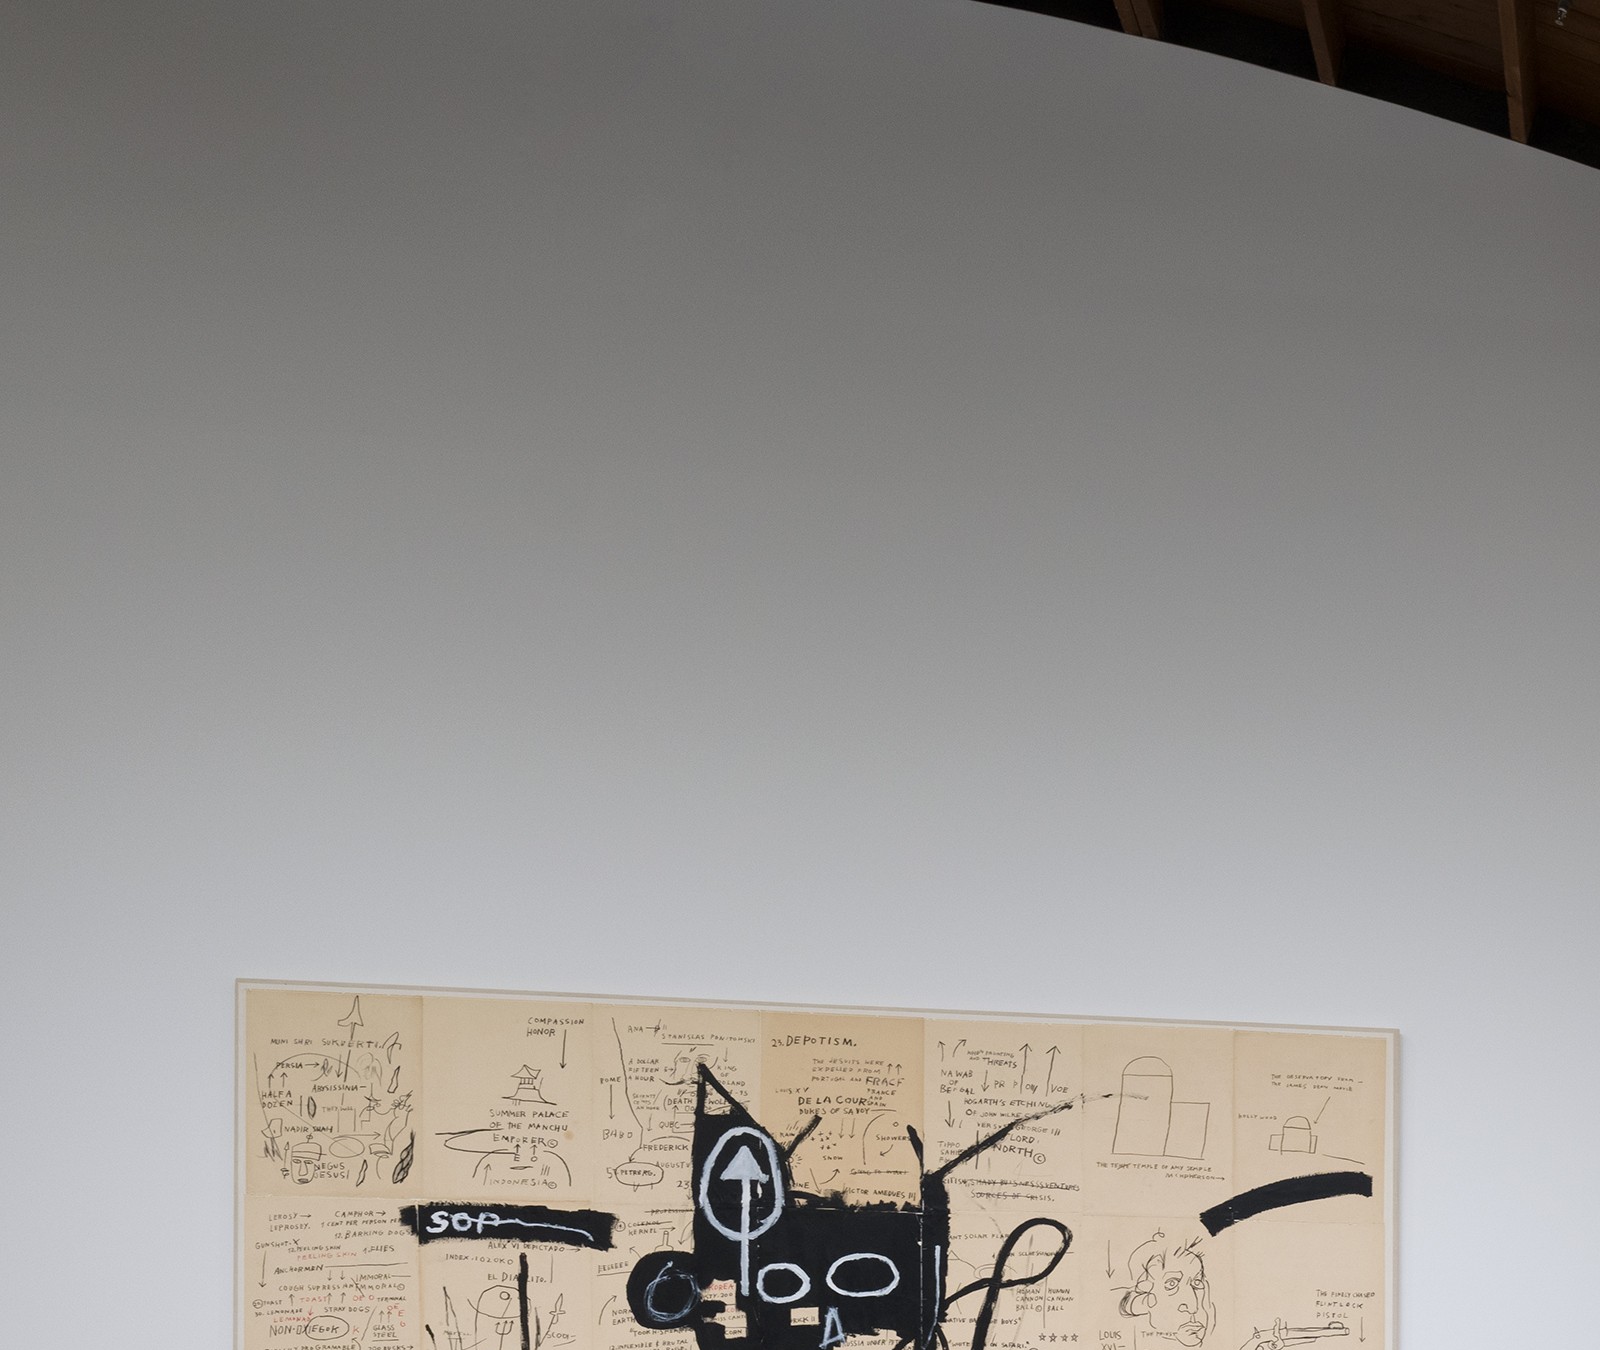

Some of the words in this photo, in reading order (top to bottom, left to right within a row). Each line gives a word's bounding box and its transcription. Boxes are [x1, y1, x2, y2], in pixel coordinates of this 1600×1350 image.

[528, 1017, 584, 1025] COMPASSION
[527, 1028, 555, 1037] HONOR
[798, 1097, 811, 1105] DE
[816, 1096, 831, 1104] LA
[489, 1109, 526, 1118] SUMMER
[528, 1123, 568, 1131] MANCHU
[344, 1230, 384, 1239] BARKING
